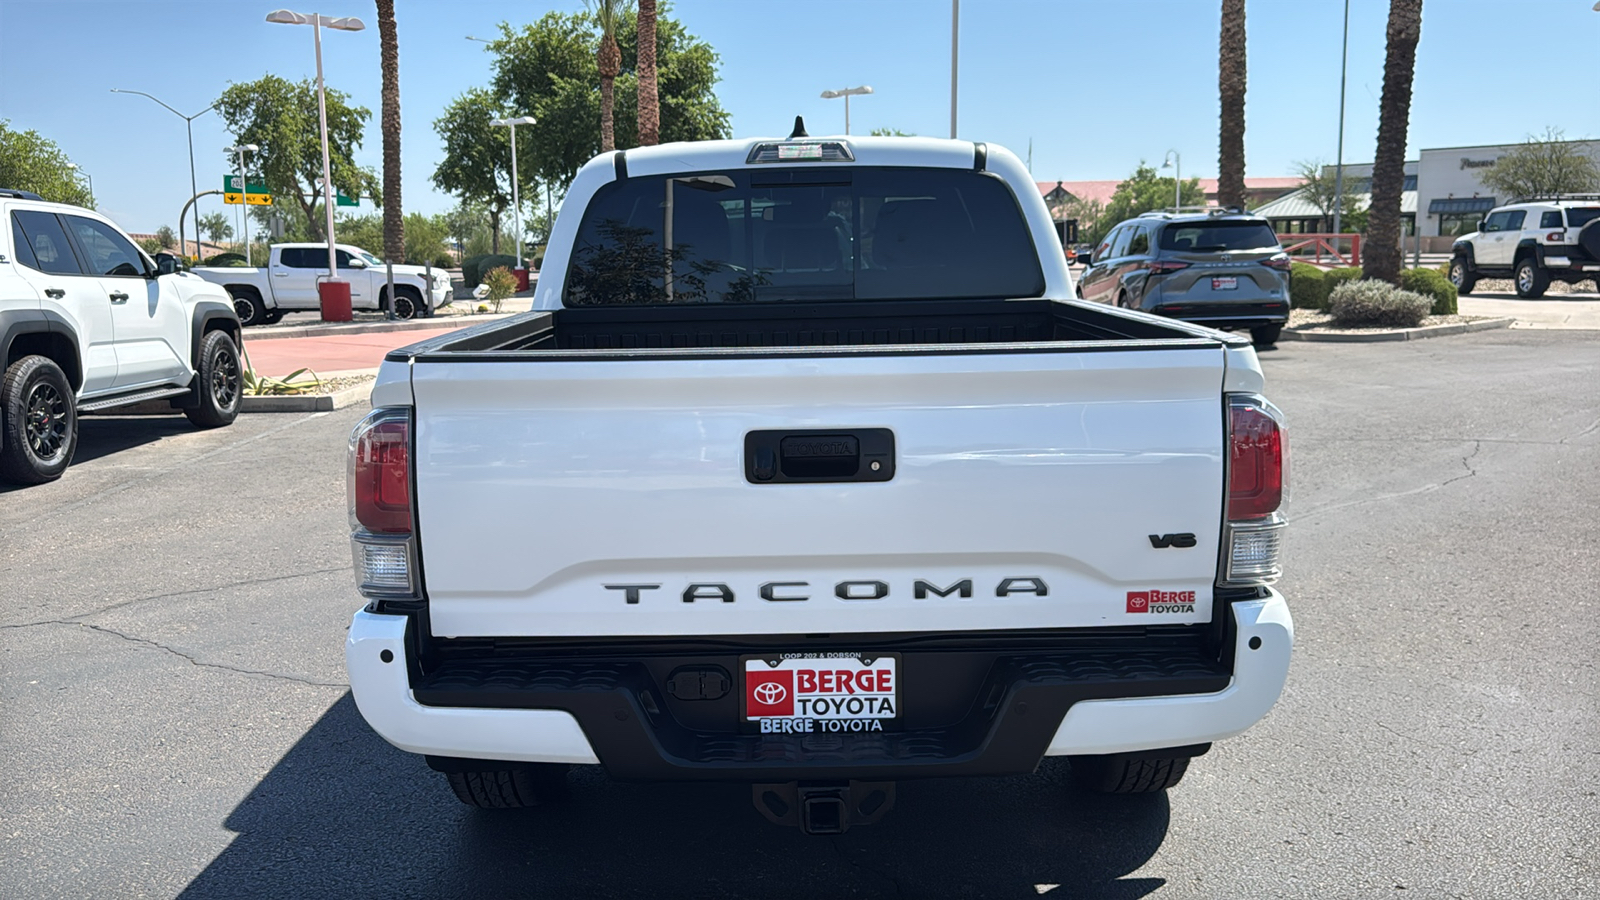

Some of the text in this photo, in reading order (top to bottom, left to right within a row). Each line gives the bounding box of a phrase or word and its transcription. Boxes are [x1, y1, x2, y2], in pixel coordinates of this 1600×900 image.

[788, 441, 853, 455] TOYOTA
[1148, 533, 1197, 549] V6
[603, 577, 1050, 604] TACOMA
[1150, 590, 1195, 603] BERGE
[1150, 605, 1194, 613] TOYOTA
[797, 669, 893, 694] BERGE
[797, 697, 895, 715] TOYOTA
[760, 718, 883, 734] BERGE TOYOTA
